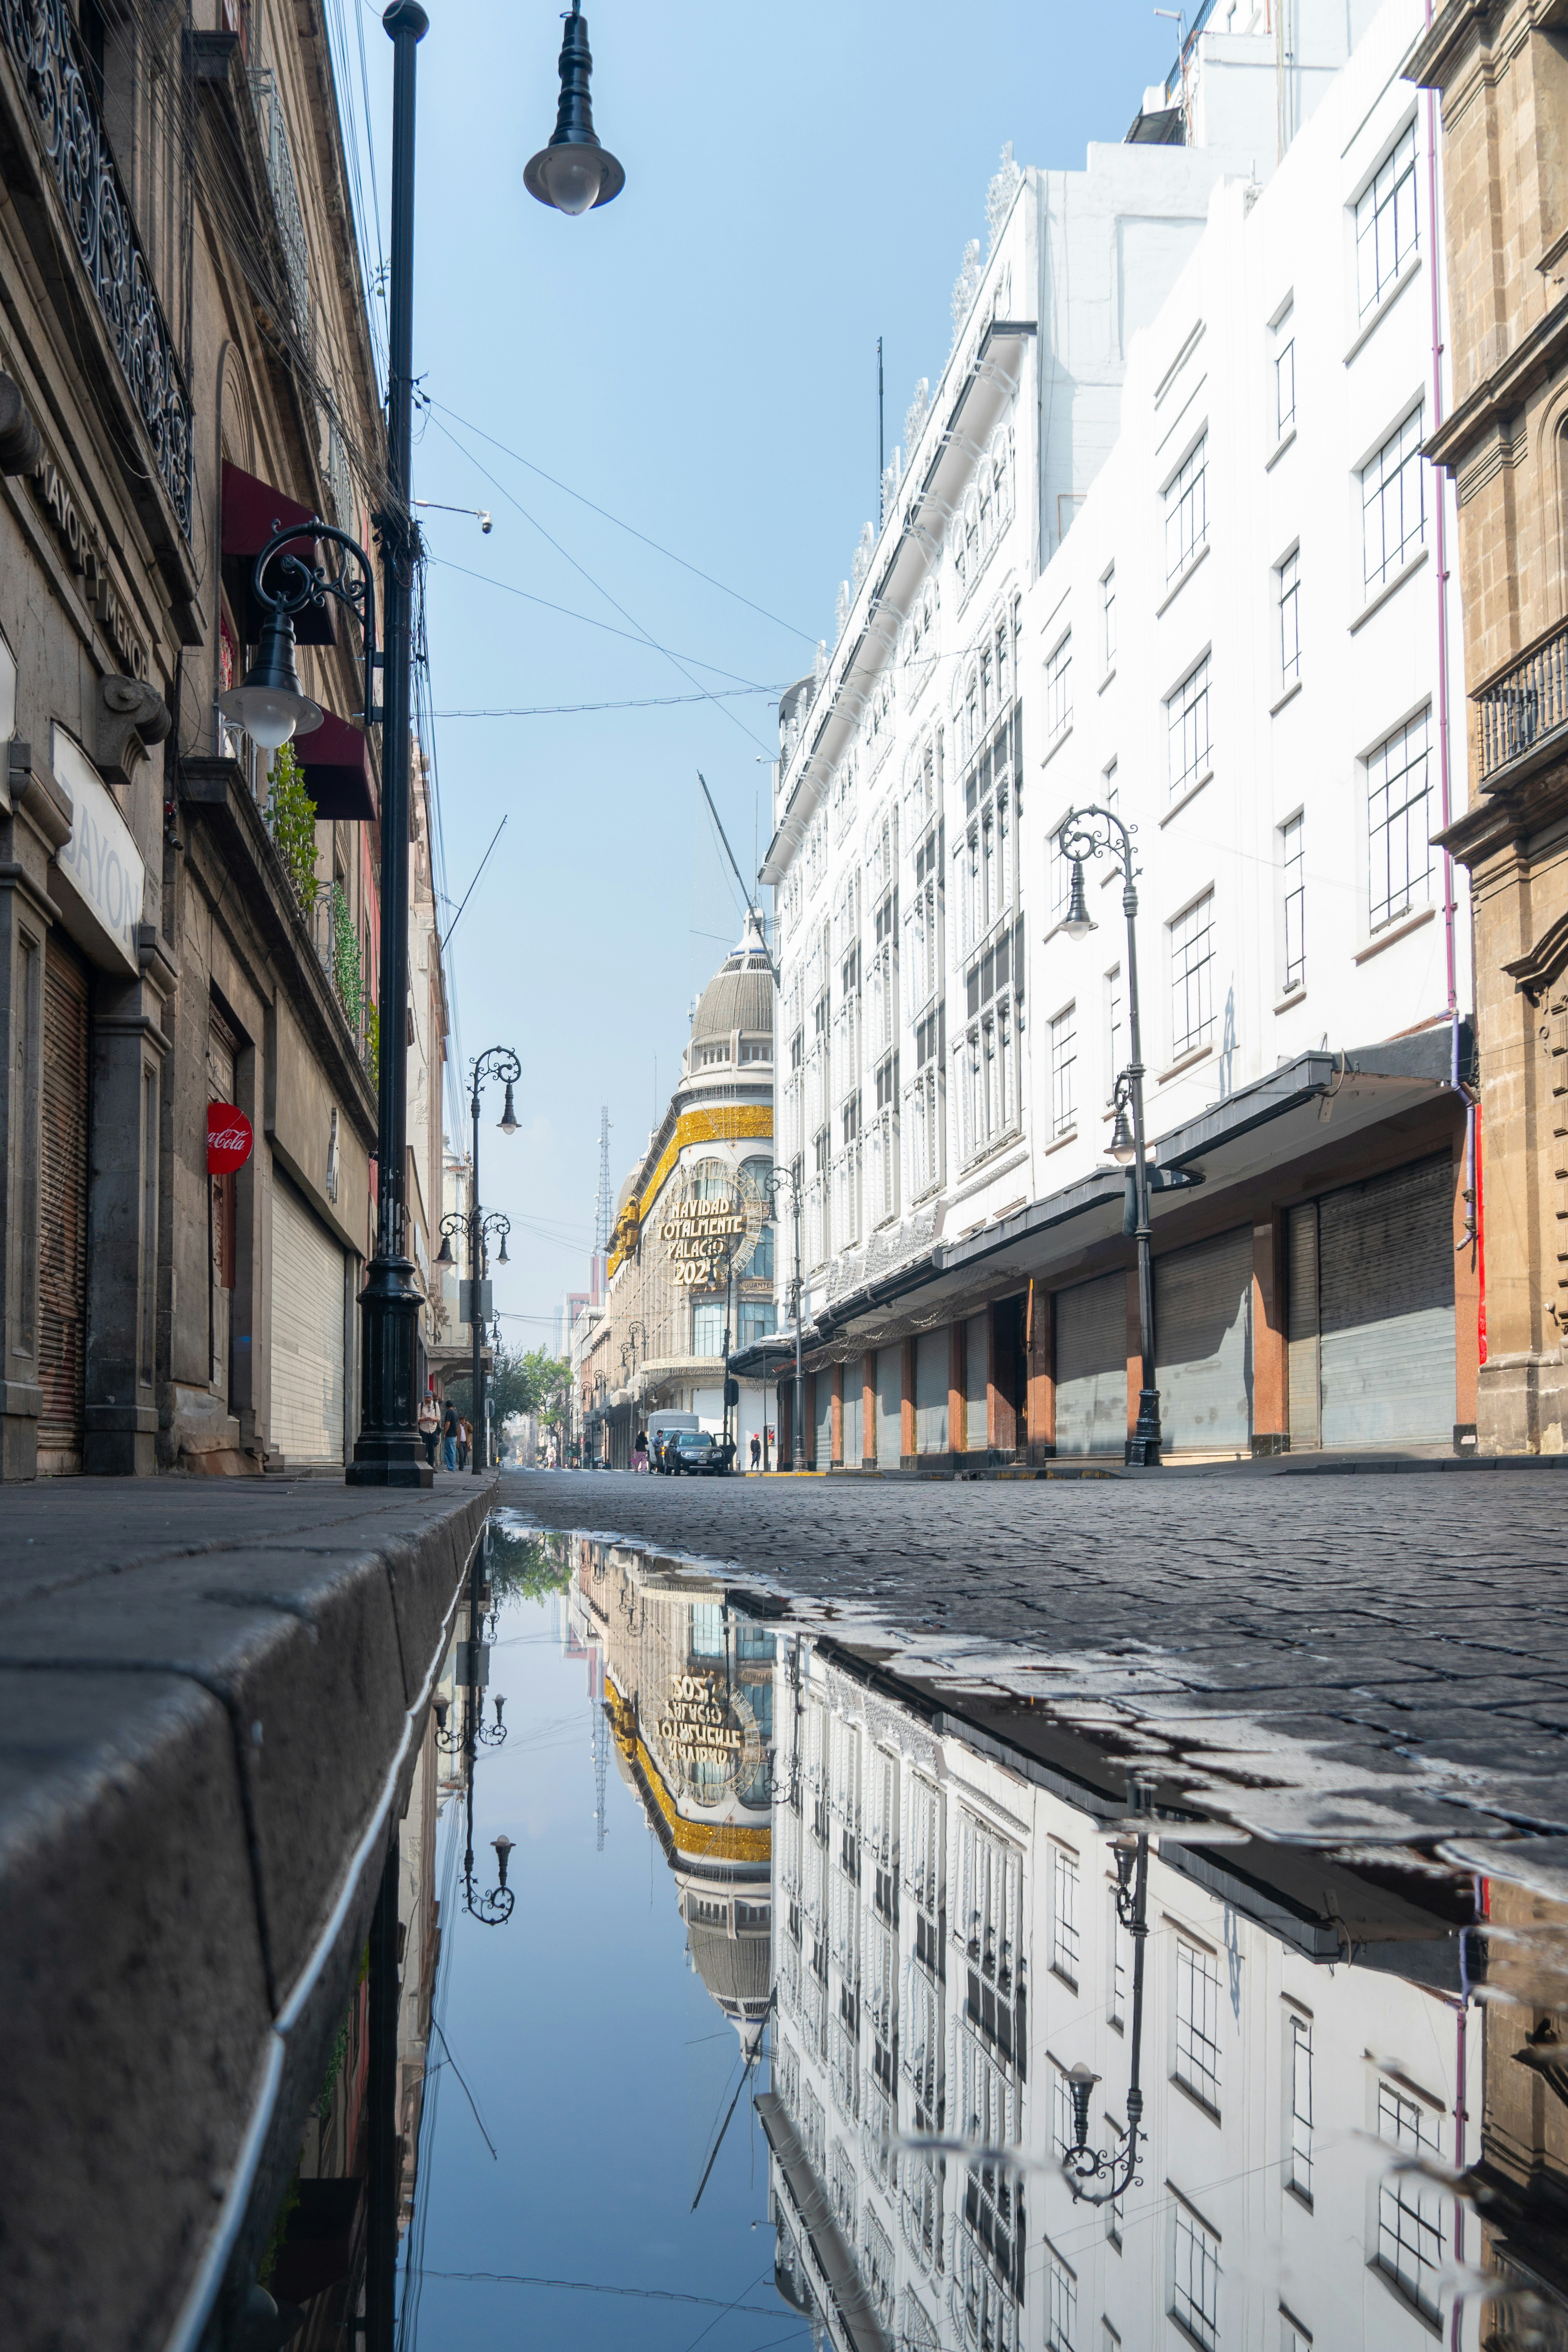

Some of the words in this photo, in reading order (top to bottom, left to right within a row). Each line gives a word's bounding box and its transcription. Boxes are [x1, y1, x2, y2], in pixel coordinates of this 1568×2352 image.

[61, 771, 139, 958] BAYON
[18, 1041, 23, 1070] 5
[671, 1197, 730, 1219] NAVIDAD
[657, 1215, 743, 1239] TOTALMENTE
[667, 1238, 725, 1259] PALACIO
[652, 1359, 681, 1367] PALACIO
